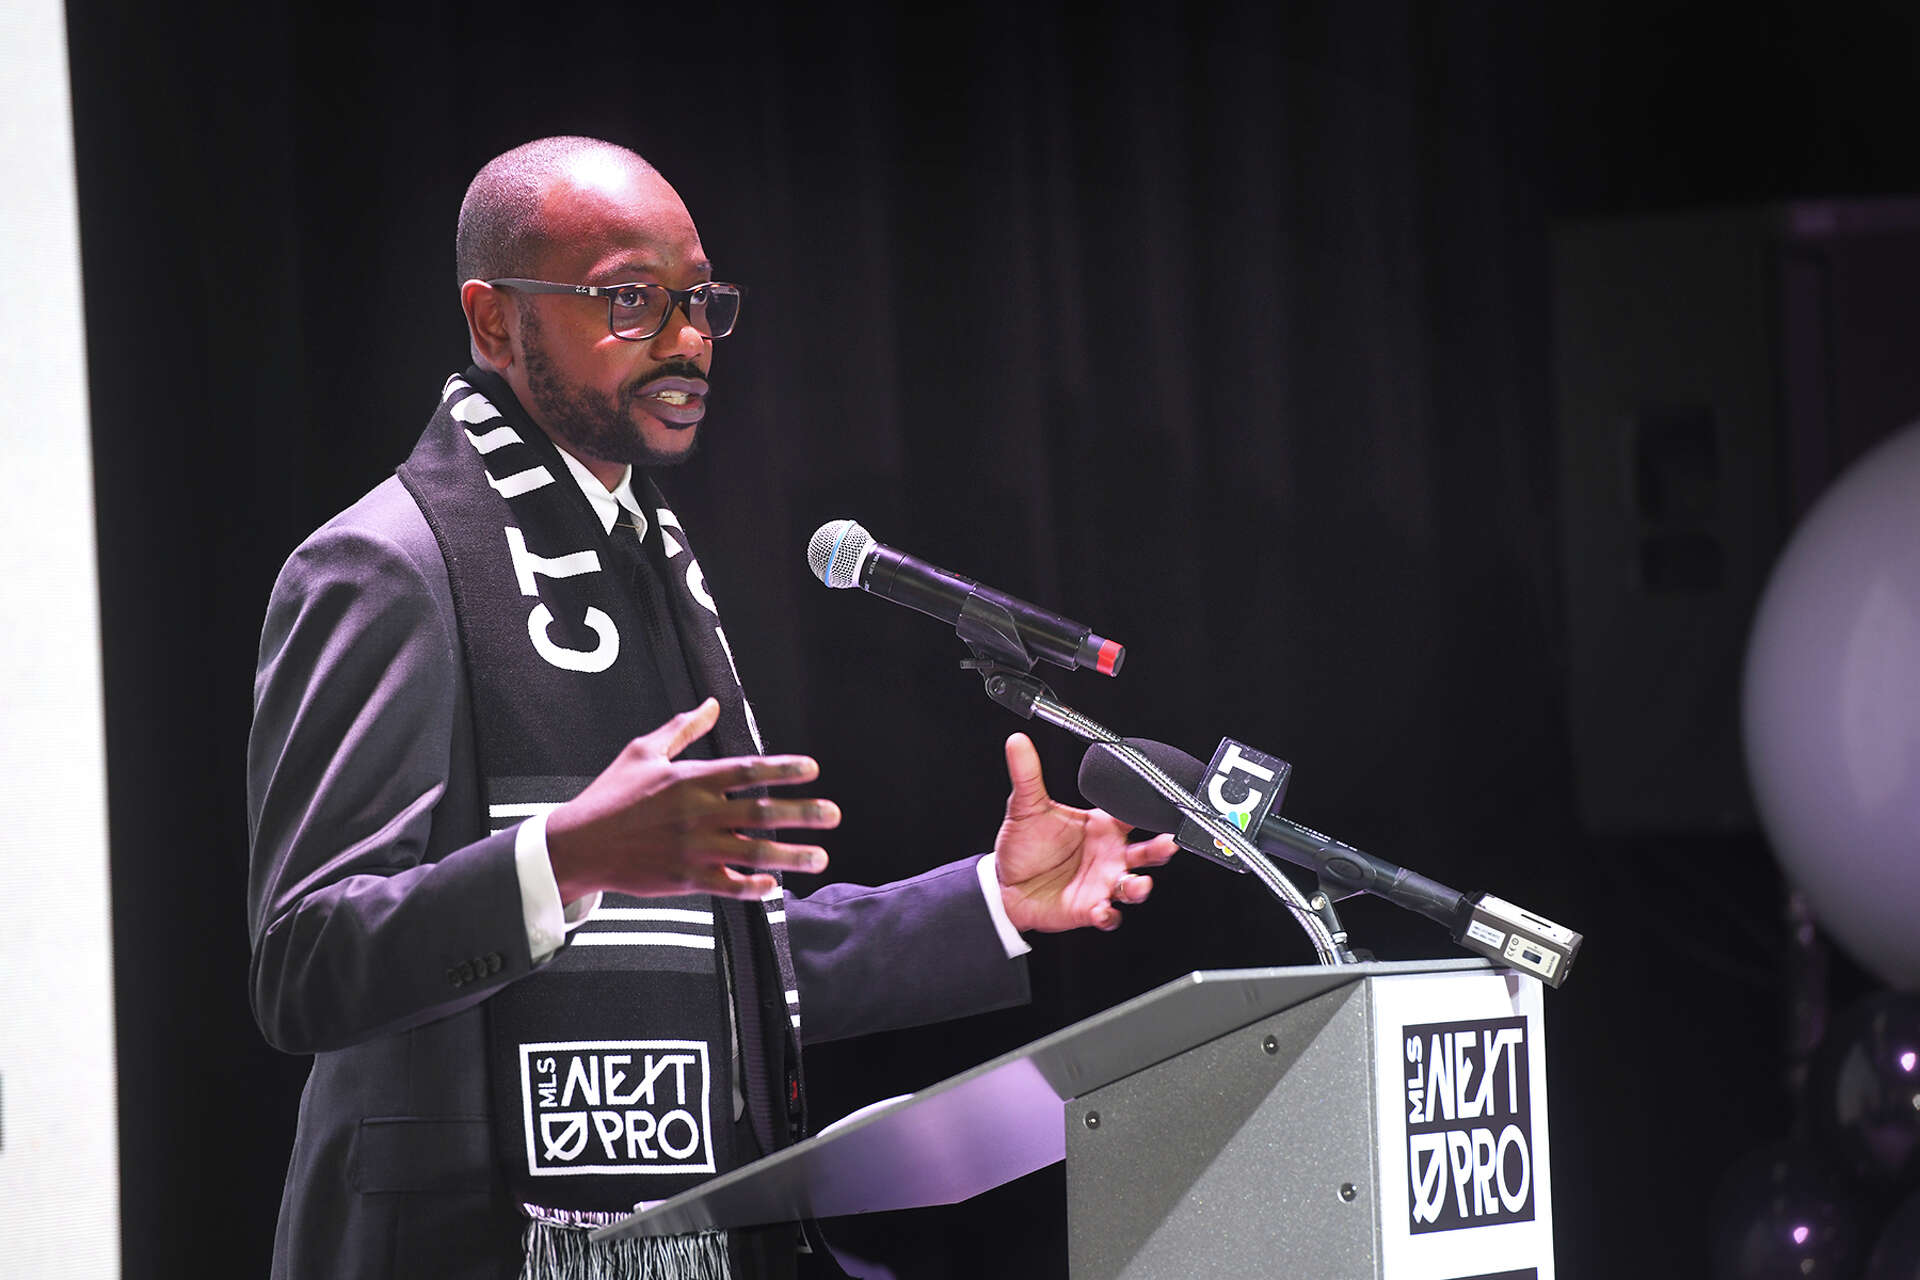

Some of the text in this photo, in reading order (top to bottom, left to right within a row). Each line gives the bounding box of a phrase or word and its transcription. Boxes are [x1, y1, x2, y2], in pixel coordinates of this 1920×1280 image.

[504, 526, 620, 674] CT
[1207, 743, 1275, 817] CT
[537, 1056, 559, 1108] MLS
[560, 1054, 696, 1107] NEXT
[1406, 1034, 1425, 1124] MLS
[1424, 1027, 1524, 1122] NEXT
[591, 1108, 700, 1160] PRO
[1446, 1123, 1531, 1214] PRO
